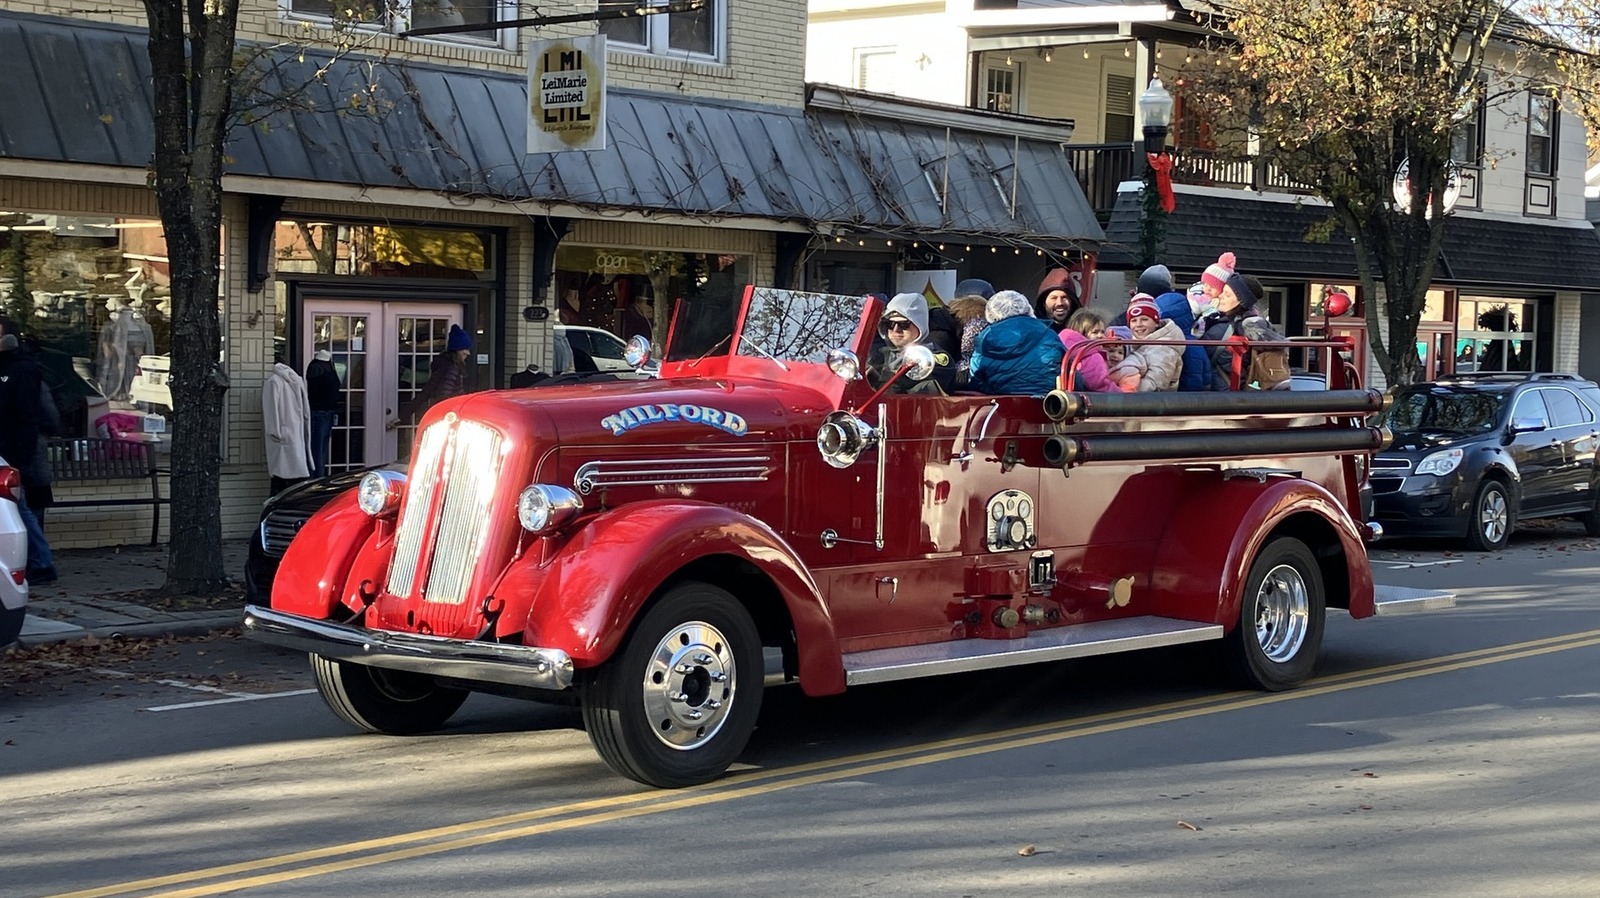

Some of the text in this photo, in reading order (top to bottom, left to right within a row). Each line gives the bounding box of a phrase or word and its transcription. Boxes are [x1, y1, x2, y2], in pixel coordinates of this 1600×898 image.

[542, 75, 587, 90] LeiMarie
[545, 91, 583, 104] Limited
[596, 254, 628, 275] open
[600, 403, 748, 437] MILFORD
[582, 481, 590, 492] S
